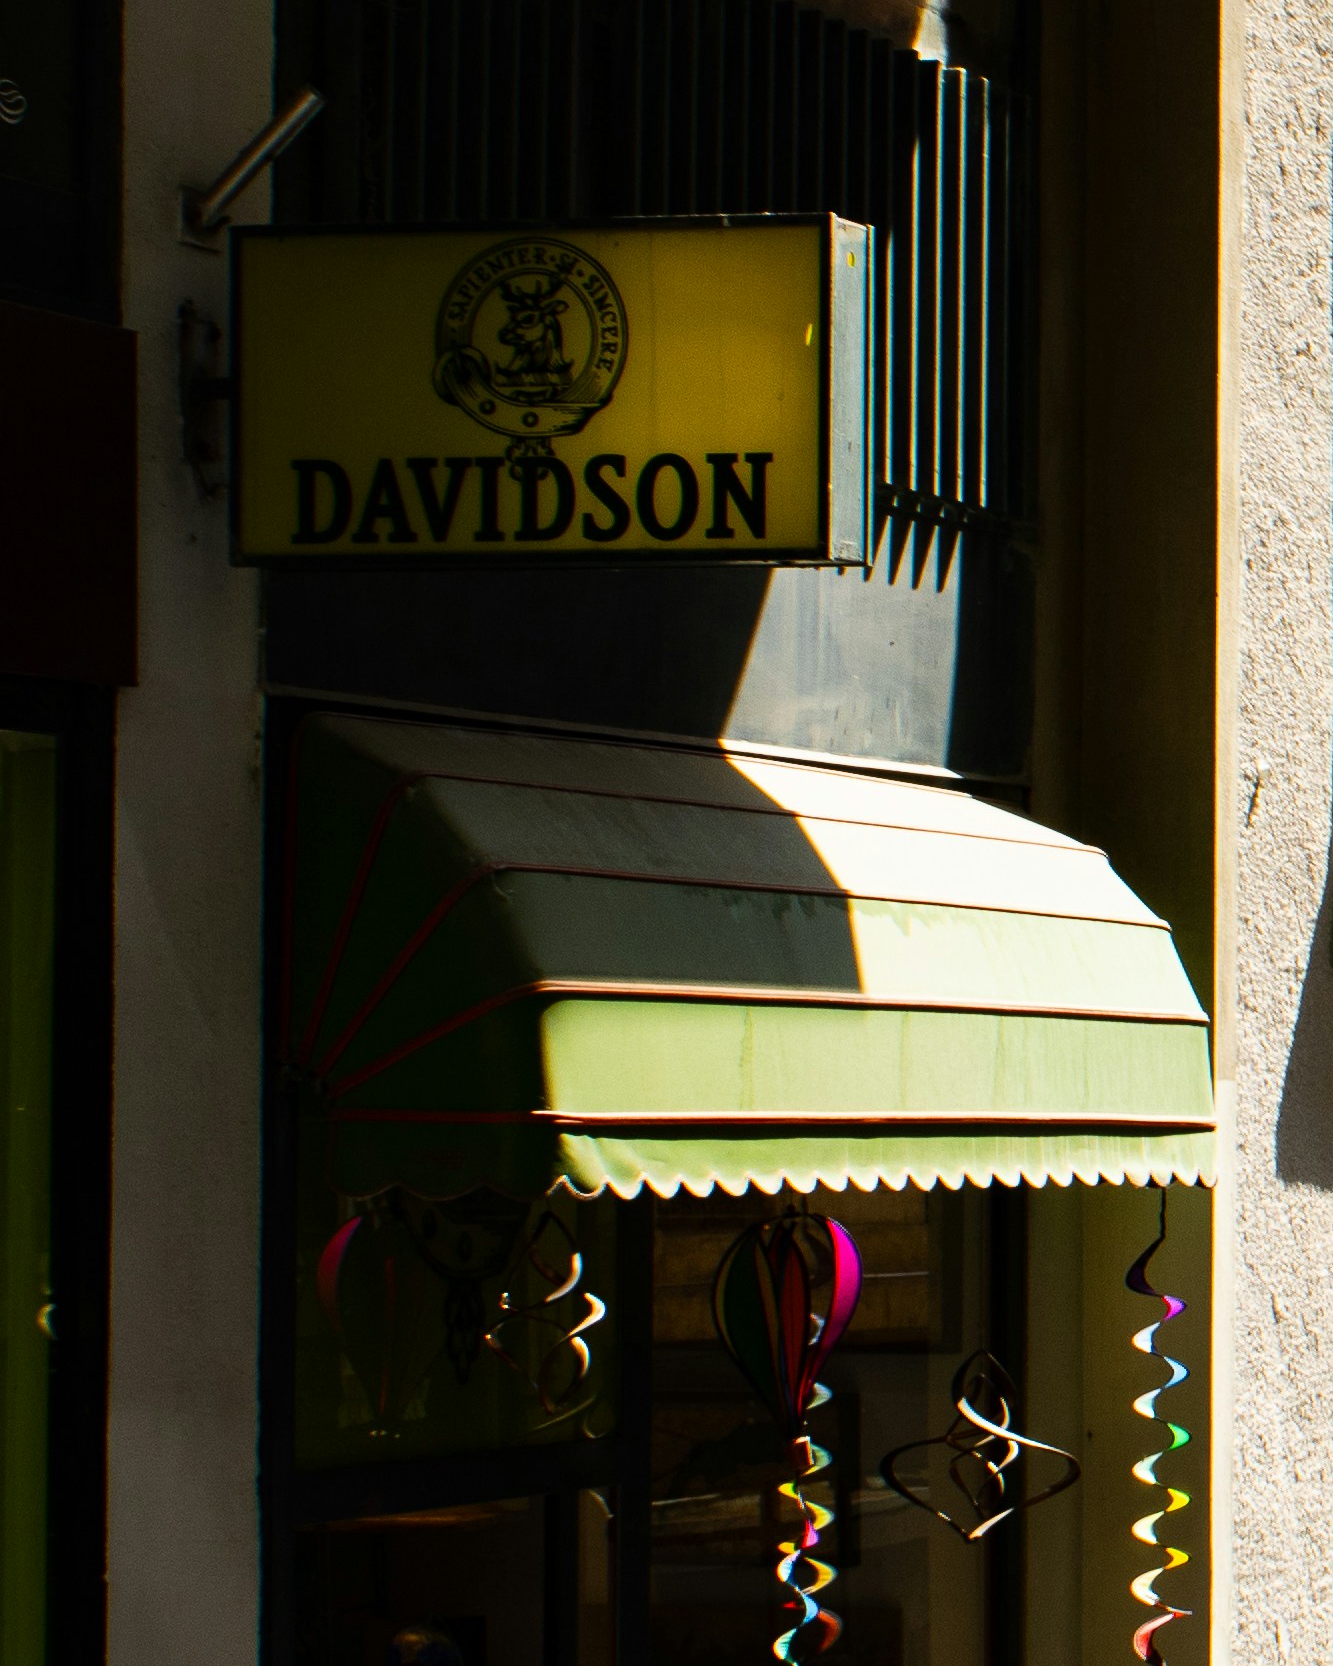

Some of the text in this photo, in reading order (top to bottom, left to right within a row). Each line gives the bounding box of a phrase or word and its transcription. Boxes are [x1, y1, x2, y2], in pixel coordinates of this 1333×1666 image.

[449, 247, 548, 322] SAPIENTER
[582, 274, 620, 373] SINCERE
[291, 451, 775, 546] DAVIDSON
